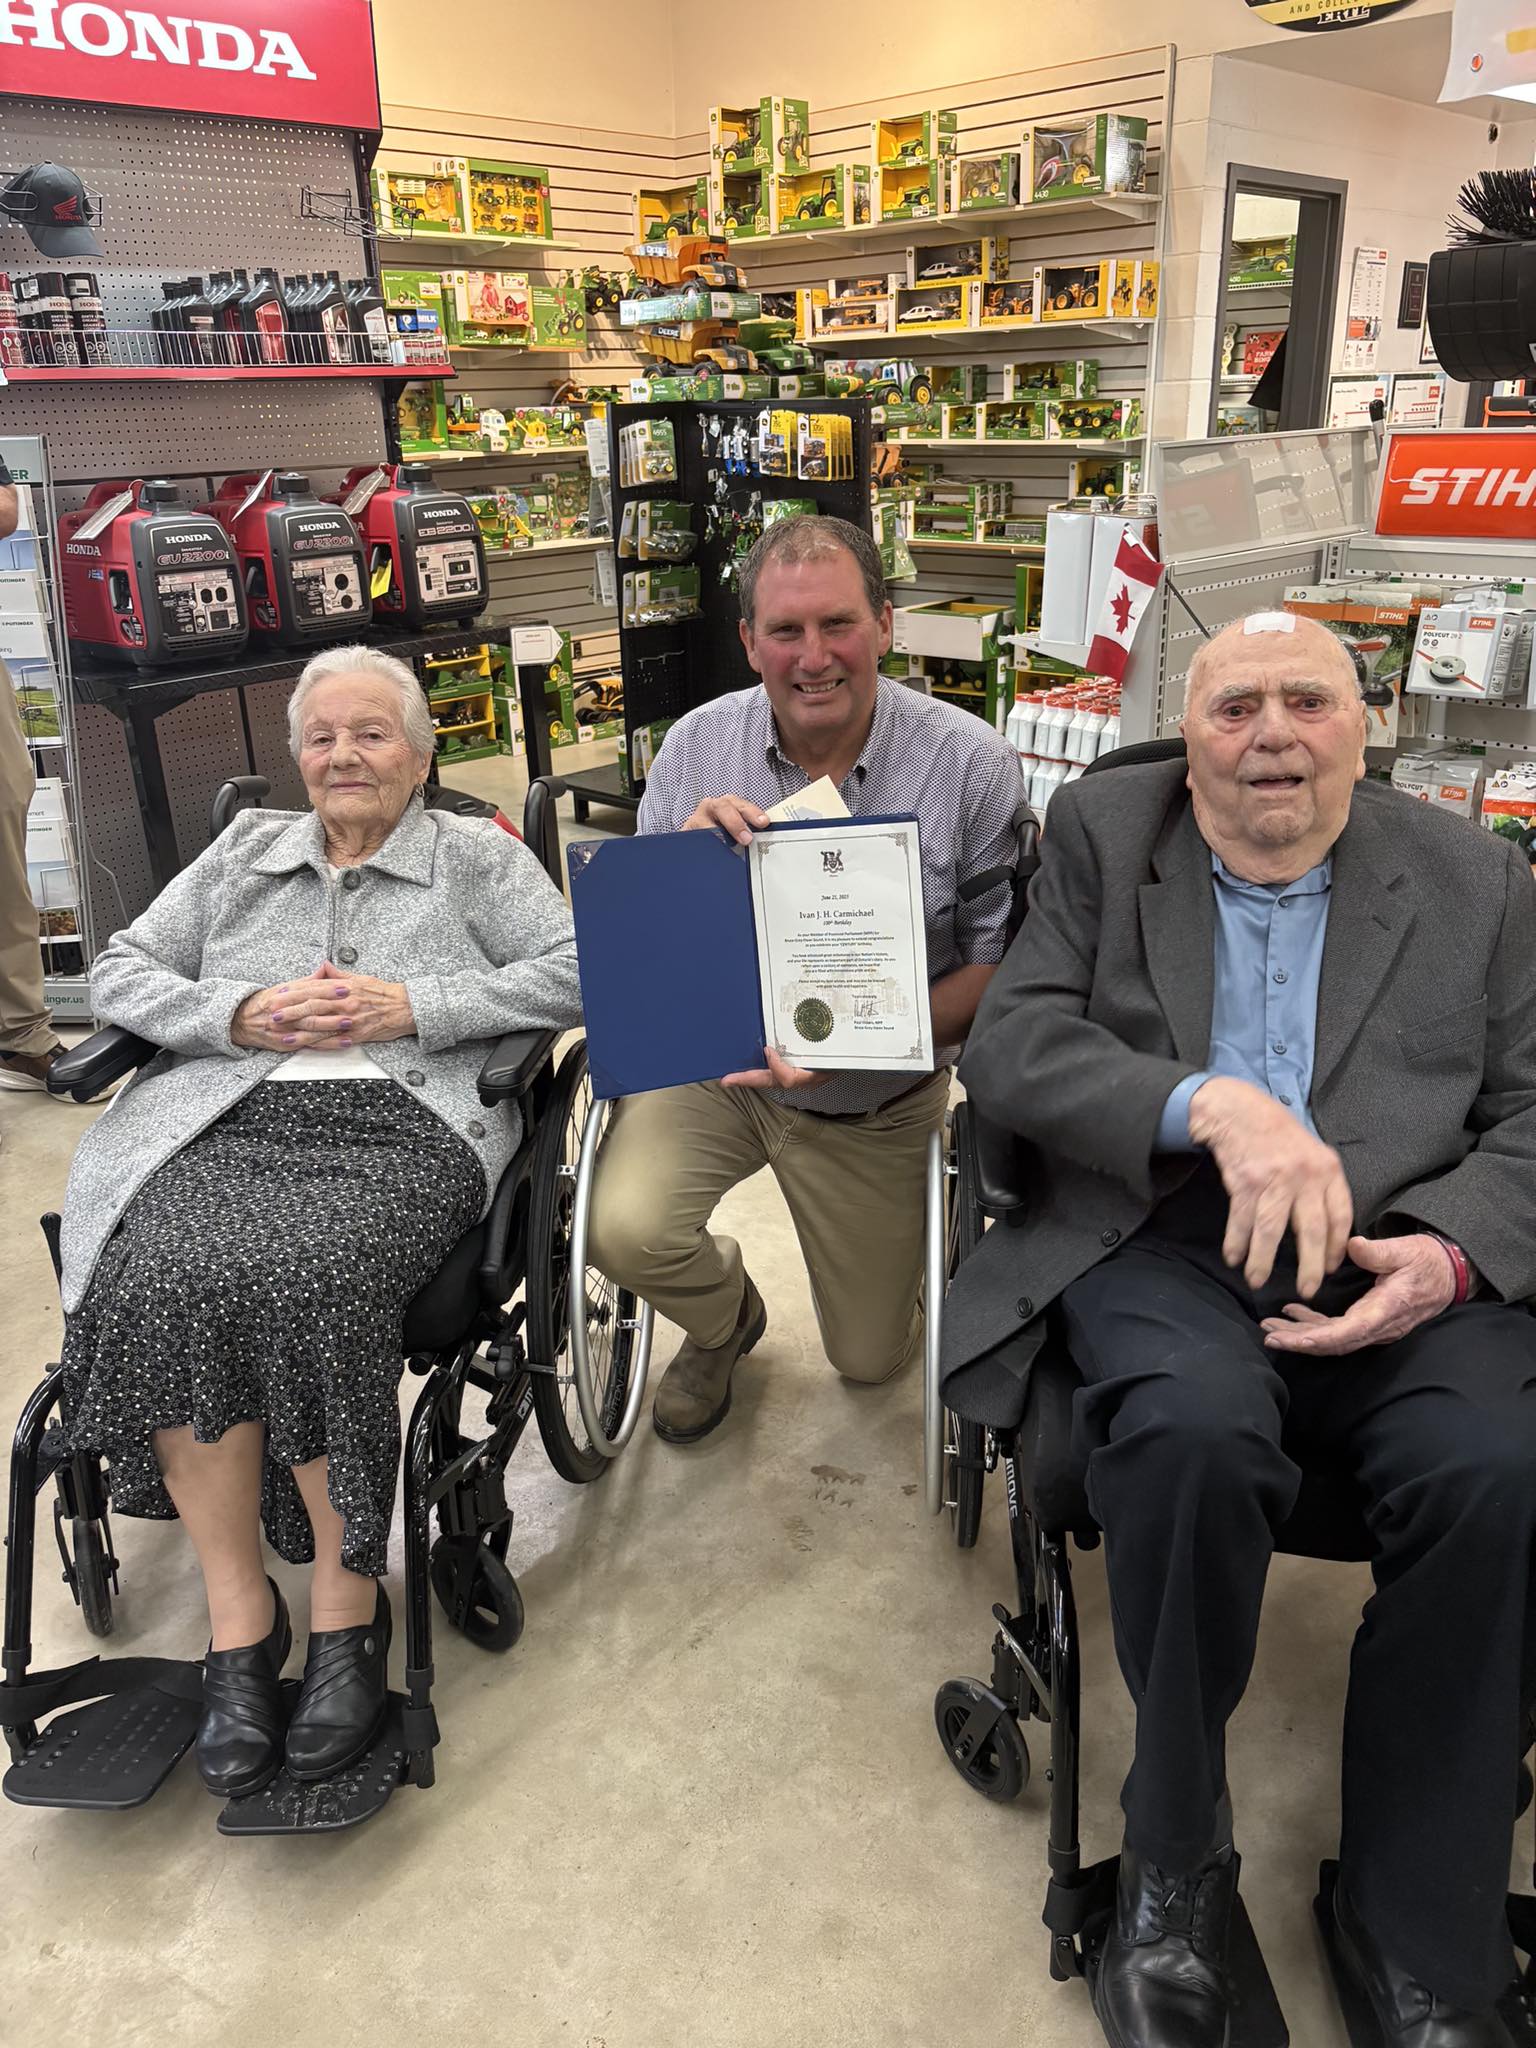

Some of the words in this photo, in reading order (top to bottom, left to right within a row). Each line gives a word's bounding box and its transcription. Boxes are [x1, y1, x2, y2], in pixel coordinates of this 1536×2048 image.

[1289, 3, 1311, 15] AND
[1316, 6, 1371, 25] ERTL
[0, 0, 317, 80] HONDA
[658, 327, 680, 337] DEERE
[12, 469, 29, 480] ER
[1401, 468, 1536, 506] STIH
[422, 508, 461, 519] HONDA
[298, 521, 341, 532] HONDA
[164, 533, 213, 544] HONDA
[66, 543, 102, 557] HONDA
[1378, 611, 1405, 621] STIHL
[1471, 619, 1493, 627] STIHL
[1395, 780, 1424, 791] POLYCUT
[1442, 788, 1464, 798] STIHL
[800, 911, 815, 919] Ivan
[816, 910, 822, 919] J.
[823, 910, 831, 918] H.
[833, 908, 874, 918] Carmichael
[43, 993, 85, 1006] tinger.us
